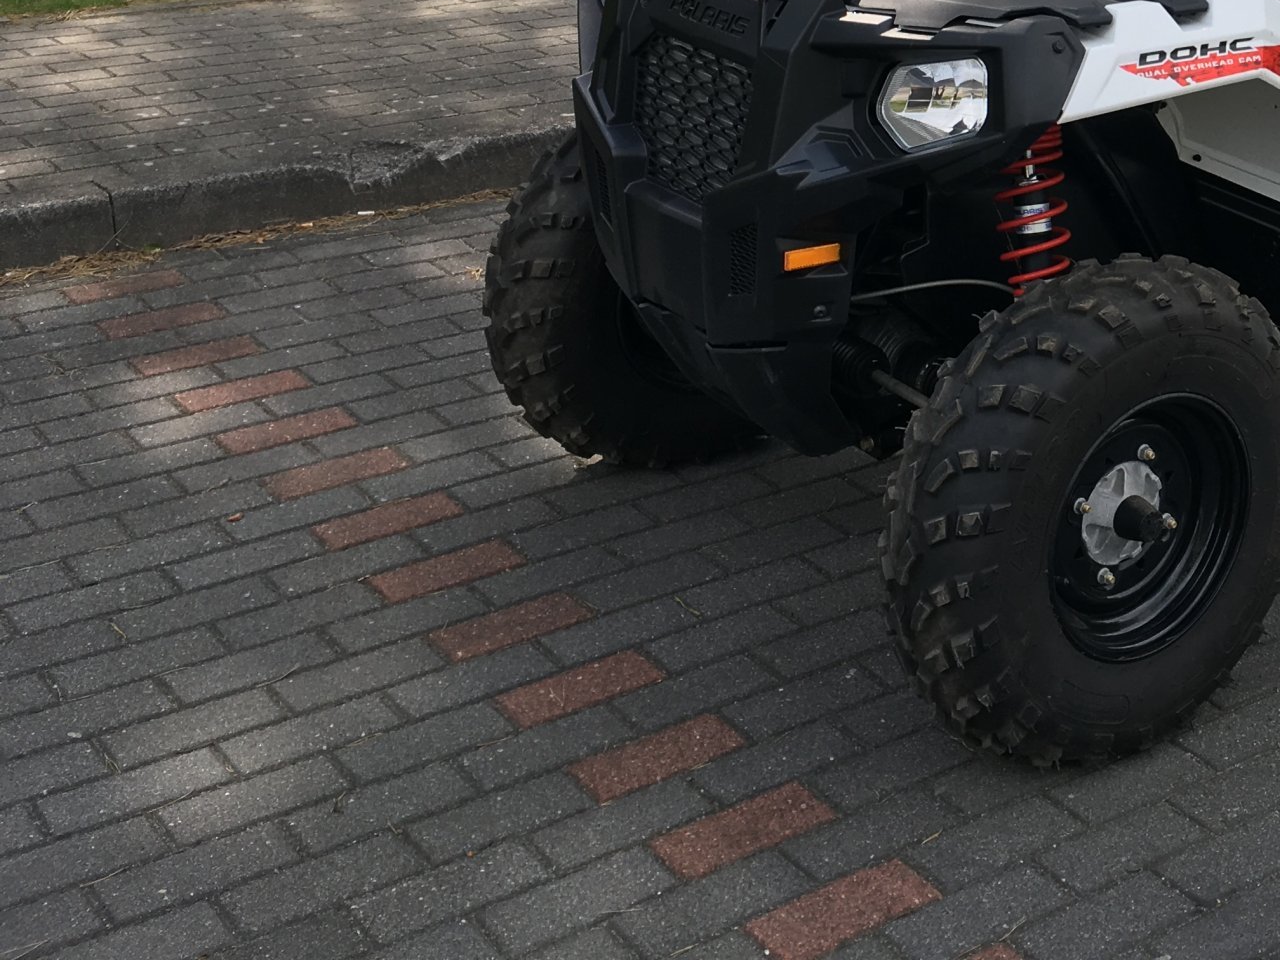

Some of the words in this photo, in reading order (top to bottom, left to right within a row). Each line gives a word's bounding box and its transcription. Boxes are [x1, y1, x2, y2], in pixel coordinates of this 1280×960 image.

[1138, 36, 1255, 67] DOHC
[1173, 58, 1234, 73] OVERHEAD
[1238, 55, 1262, 64] CAM
